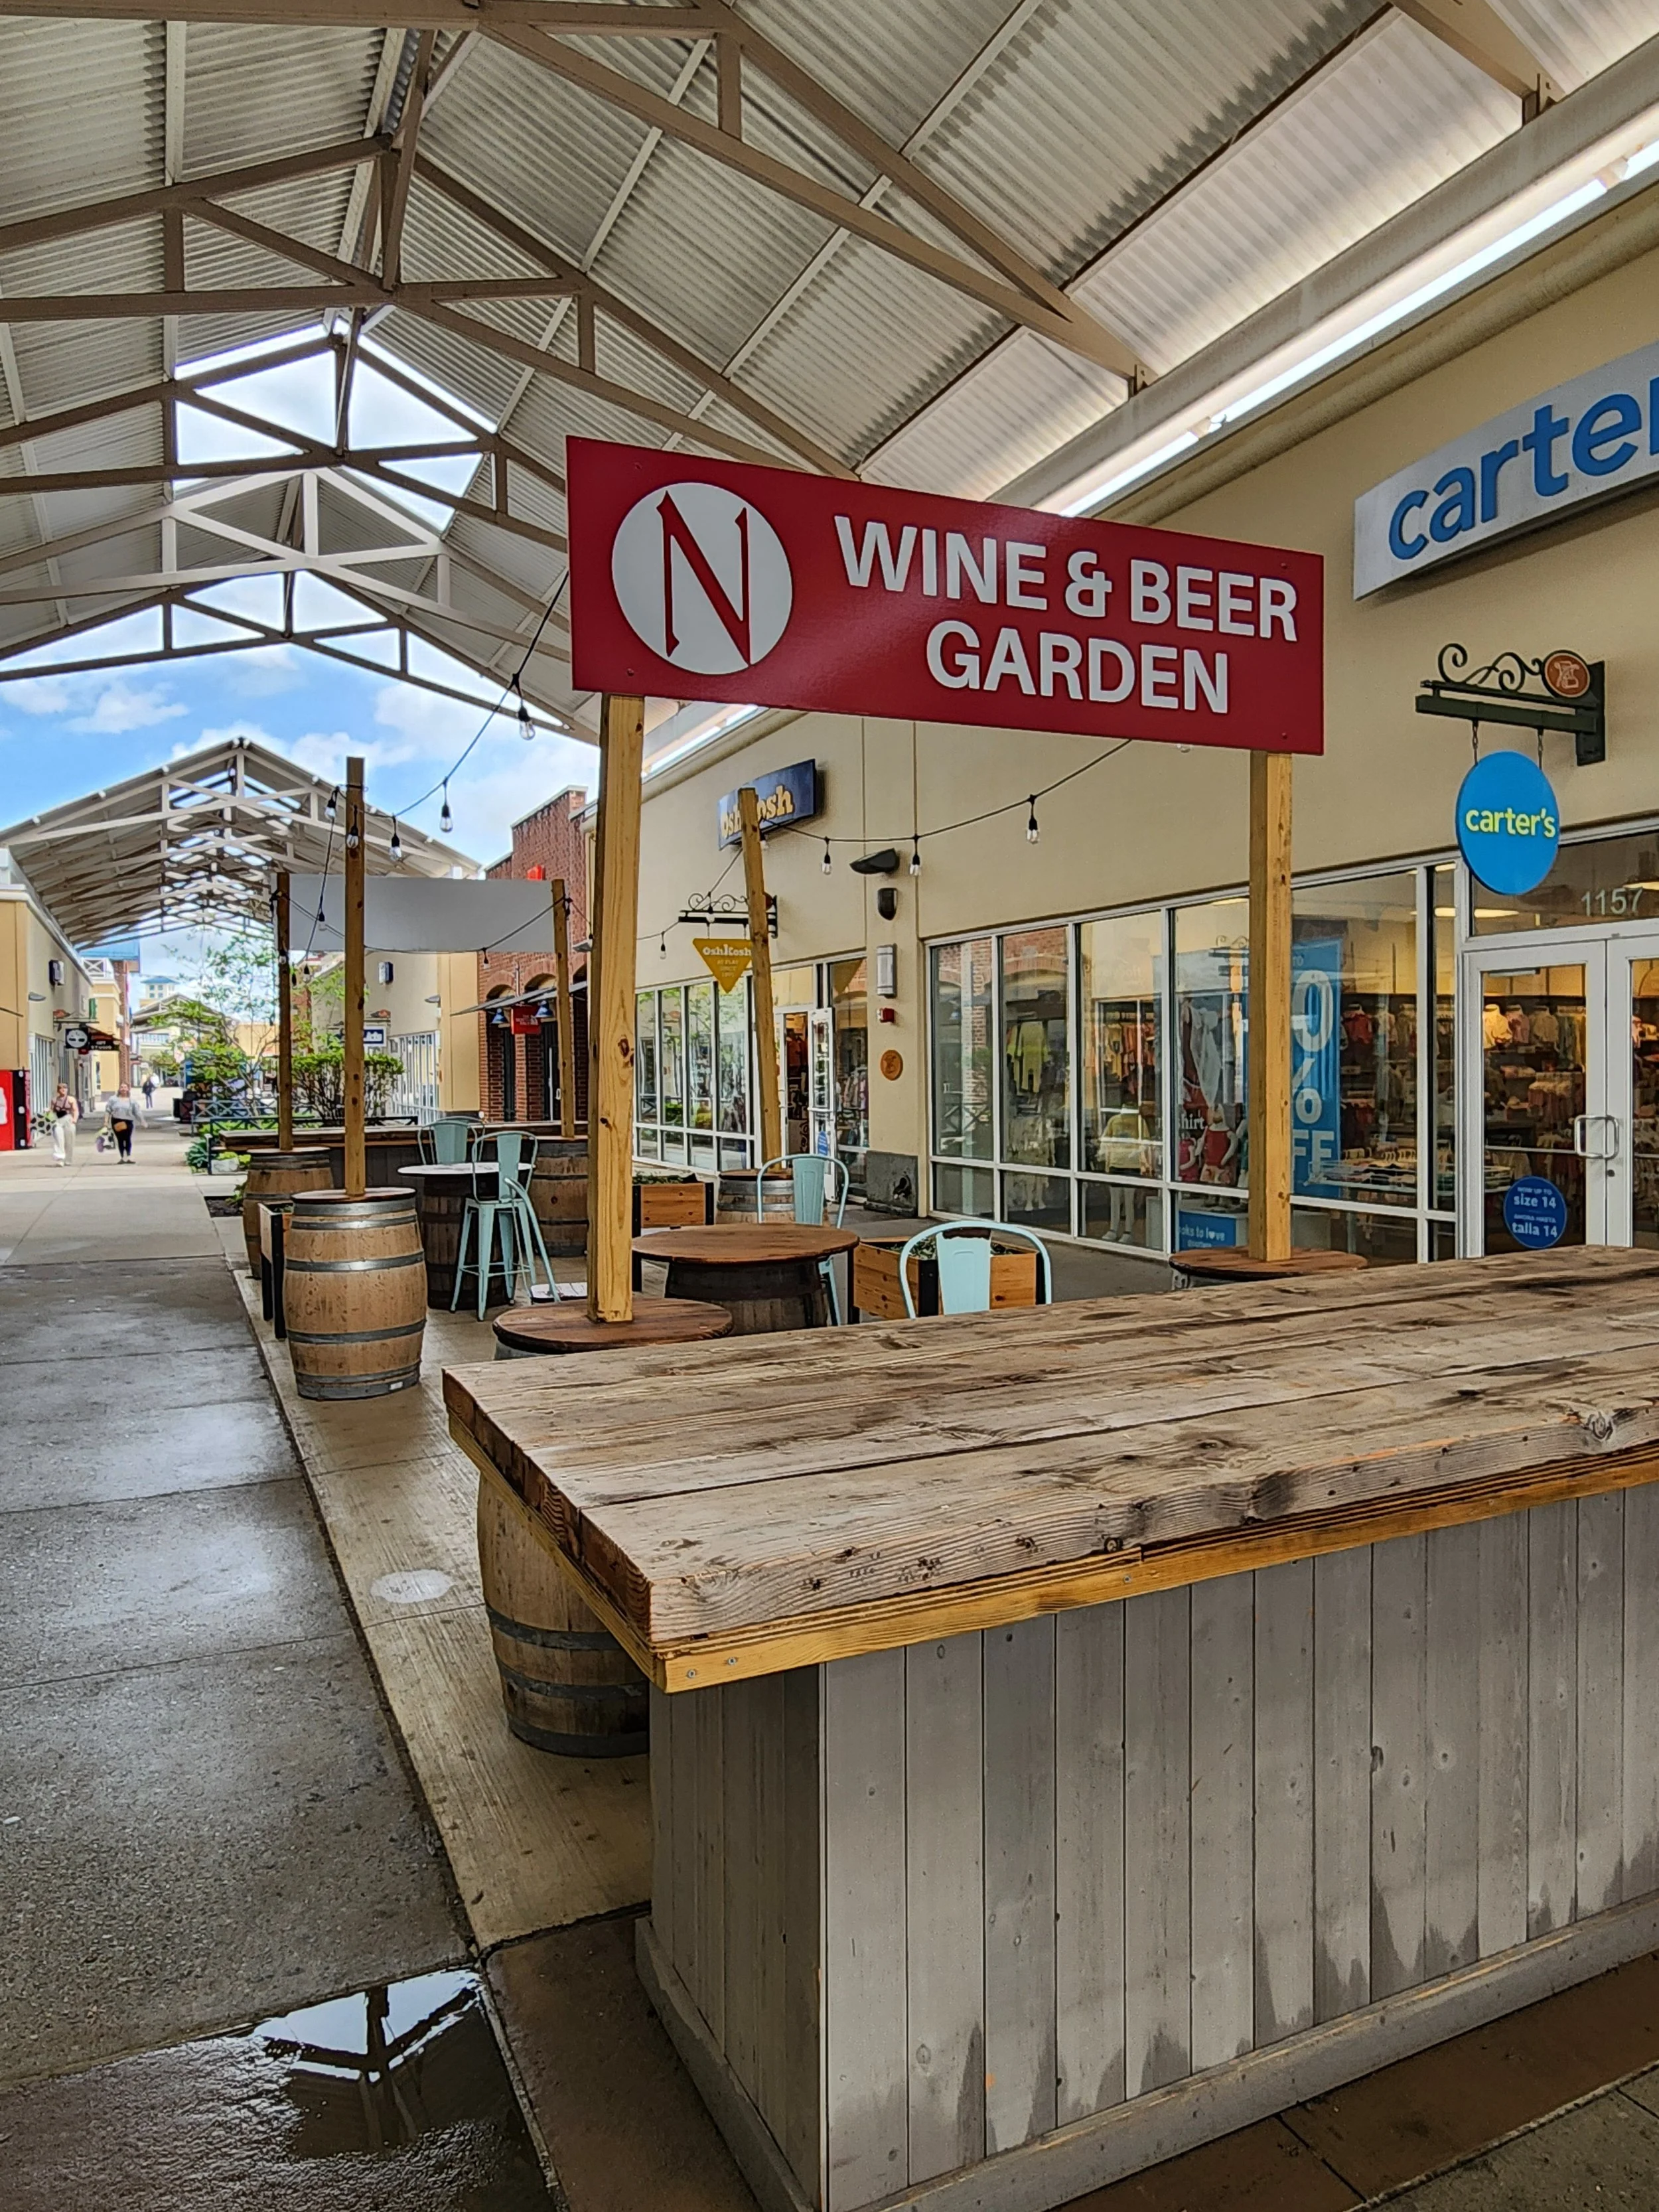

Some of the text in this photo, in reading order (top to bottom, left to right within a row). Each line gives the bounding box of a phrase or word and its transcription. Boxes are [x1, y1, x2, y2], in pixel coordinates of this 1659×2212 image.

[1388, 377, 1659, 560] carte
[834, 515, 1298, 642] WINE & BEER
[926, 621, 1230, 715] GARDEN
[720, 785, 793, 839] Oshosh
[1465, 808, 1555, 838] carter's
[1581, 887, 1643, 917] 1157
[702, 943, 751, 956] OshKosh
[1291, 970, 1334, 1053] 0
[1292, 1129, 1334, 1175] FF
[1514, 1193, 1557, 1209] size 14
[1512, 1222, 1558, 1238] talla 14
